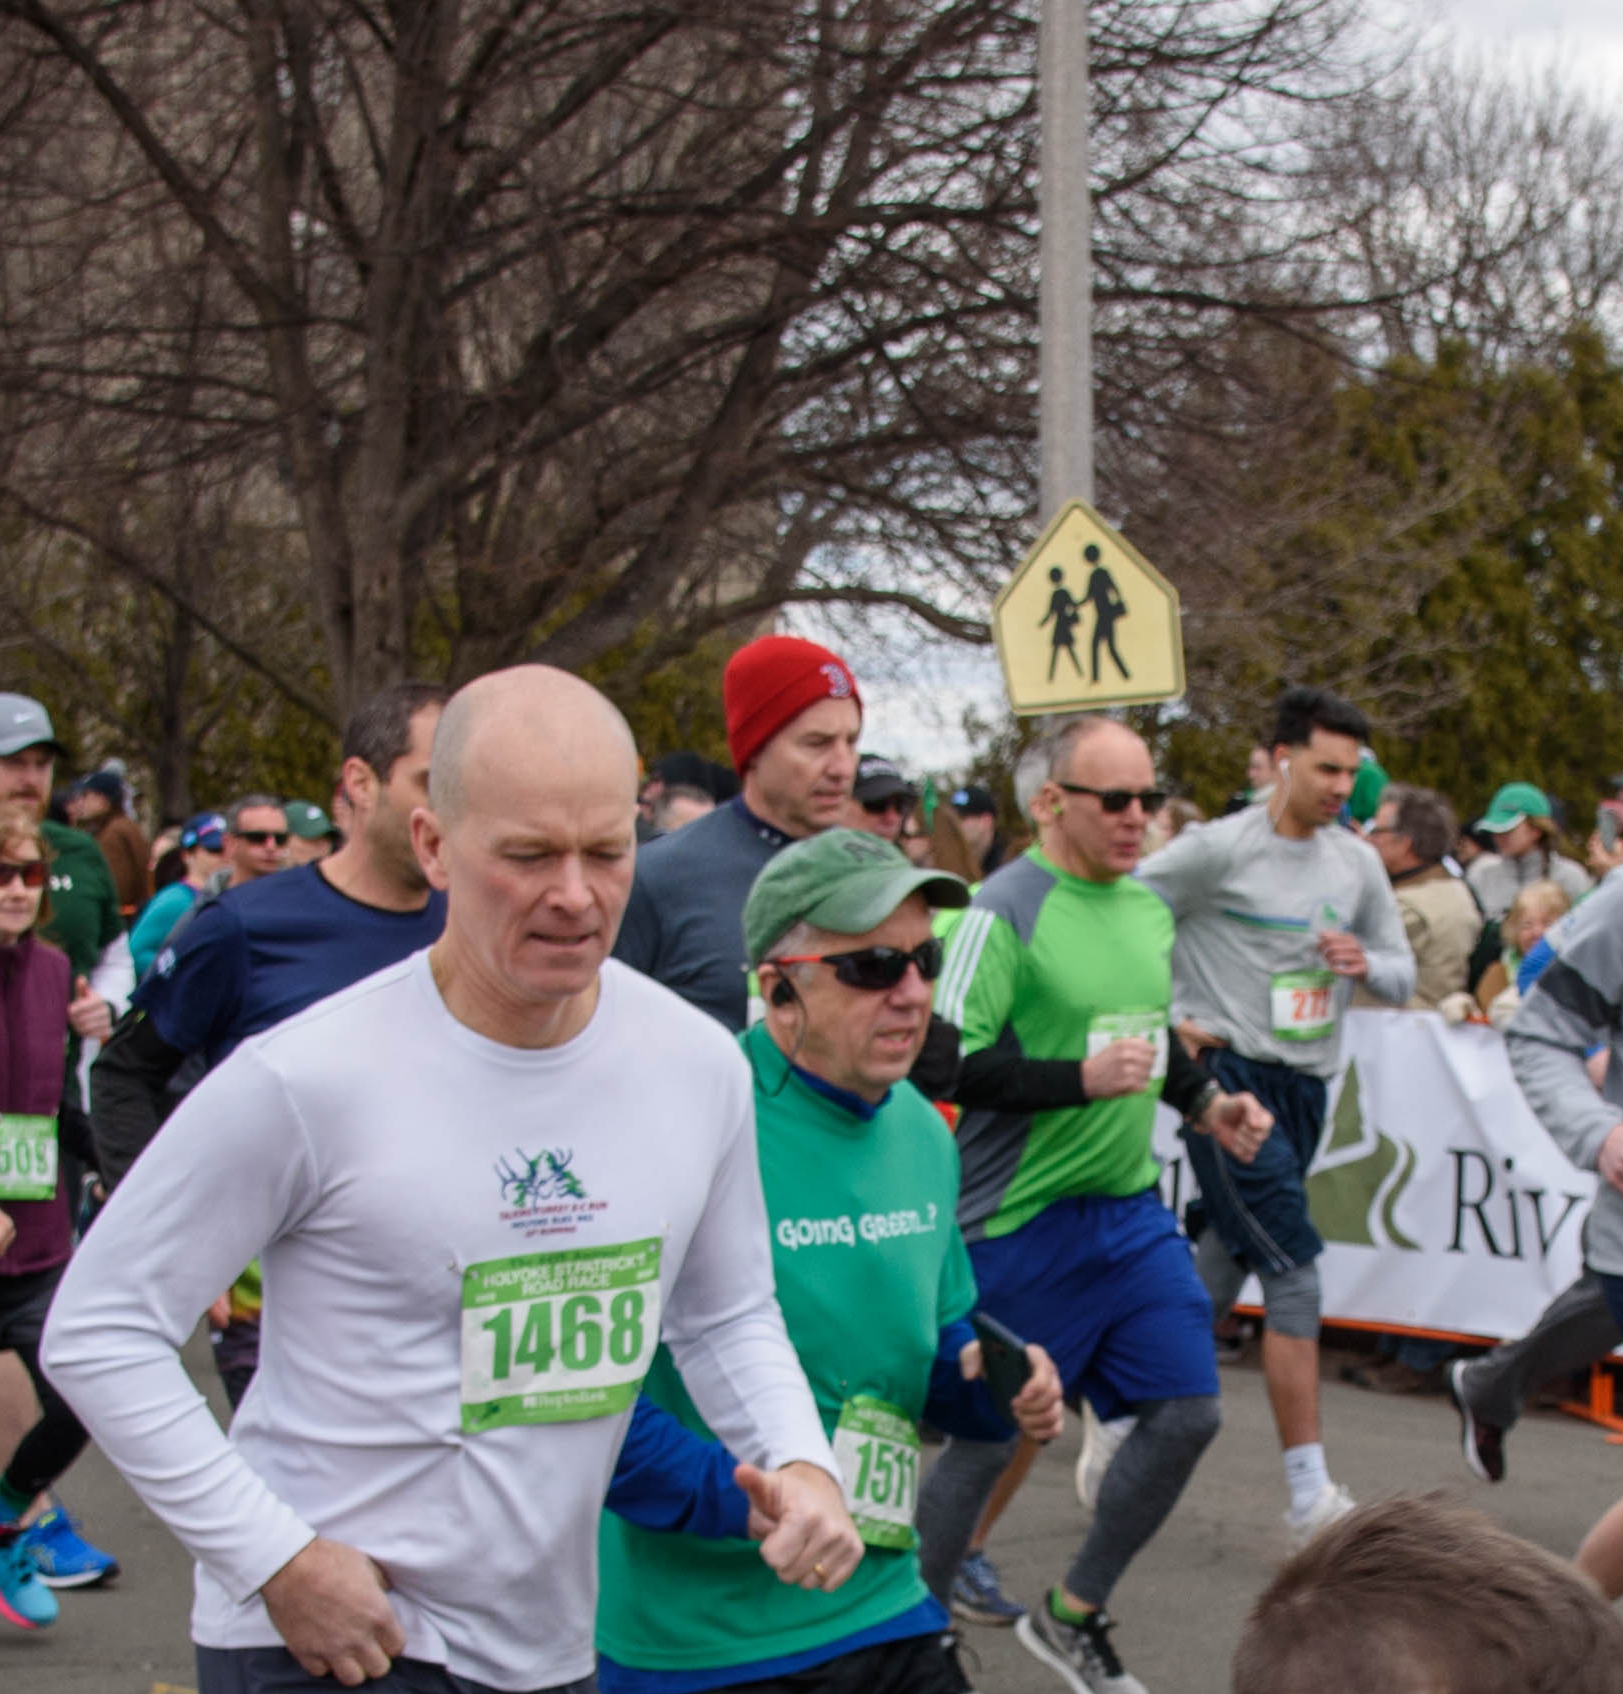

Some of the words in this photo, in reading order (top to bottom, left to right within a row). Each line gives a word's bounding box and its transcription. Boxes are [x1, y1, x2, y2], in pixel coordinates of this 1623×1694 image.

[1446, 1147, 1586, 1260] Riv
[484, 1263, 552, 1288] HOLYOKE
[521, 1279, 564, 1296] ROAD
[566, 1274, 611, 1291] RACE
[482, 1289, 645, 1381] 1468
[854, 1439, 914, 1508] 1511
